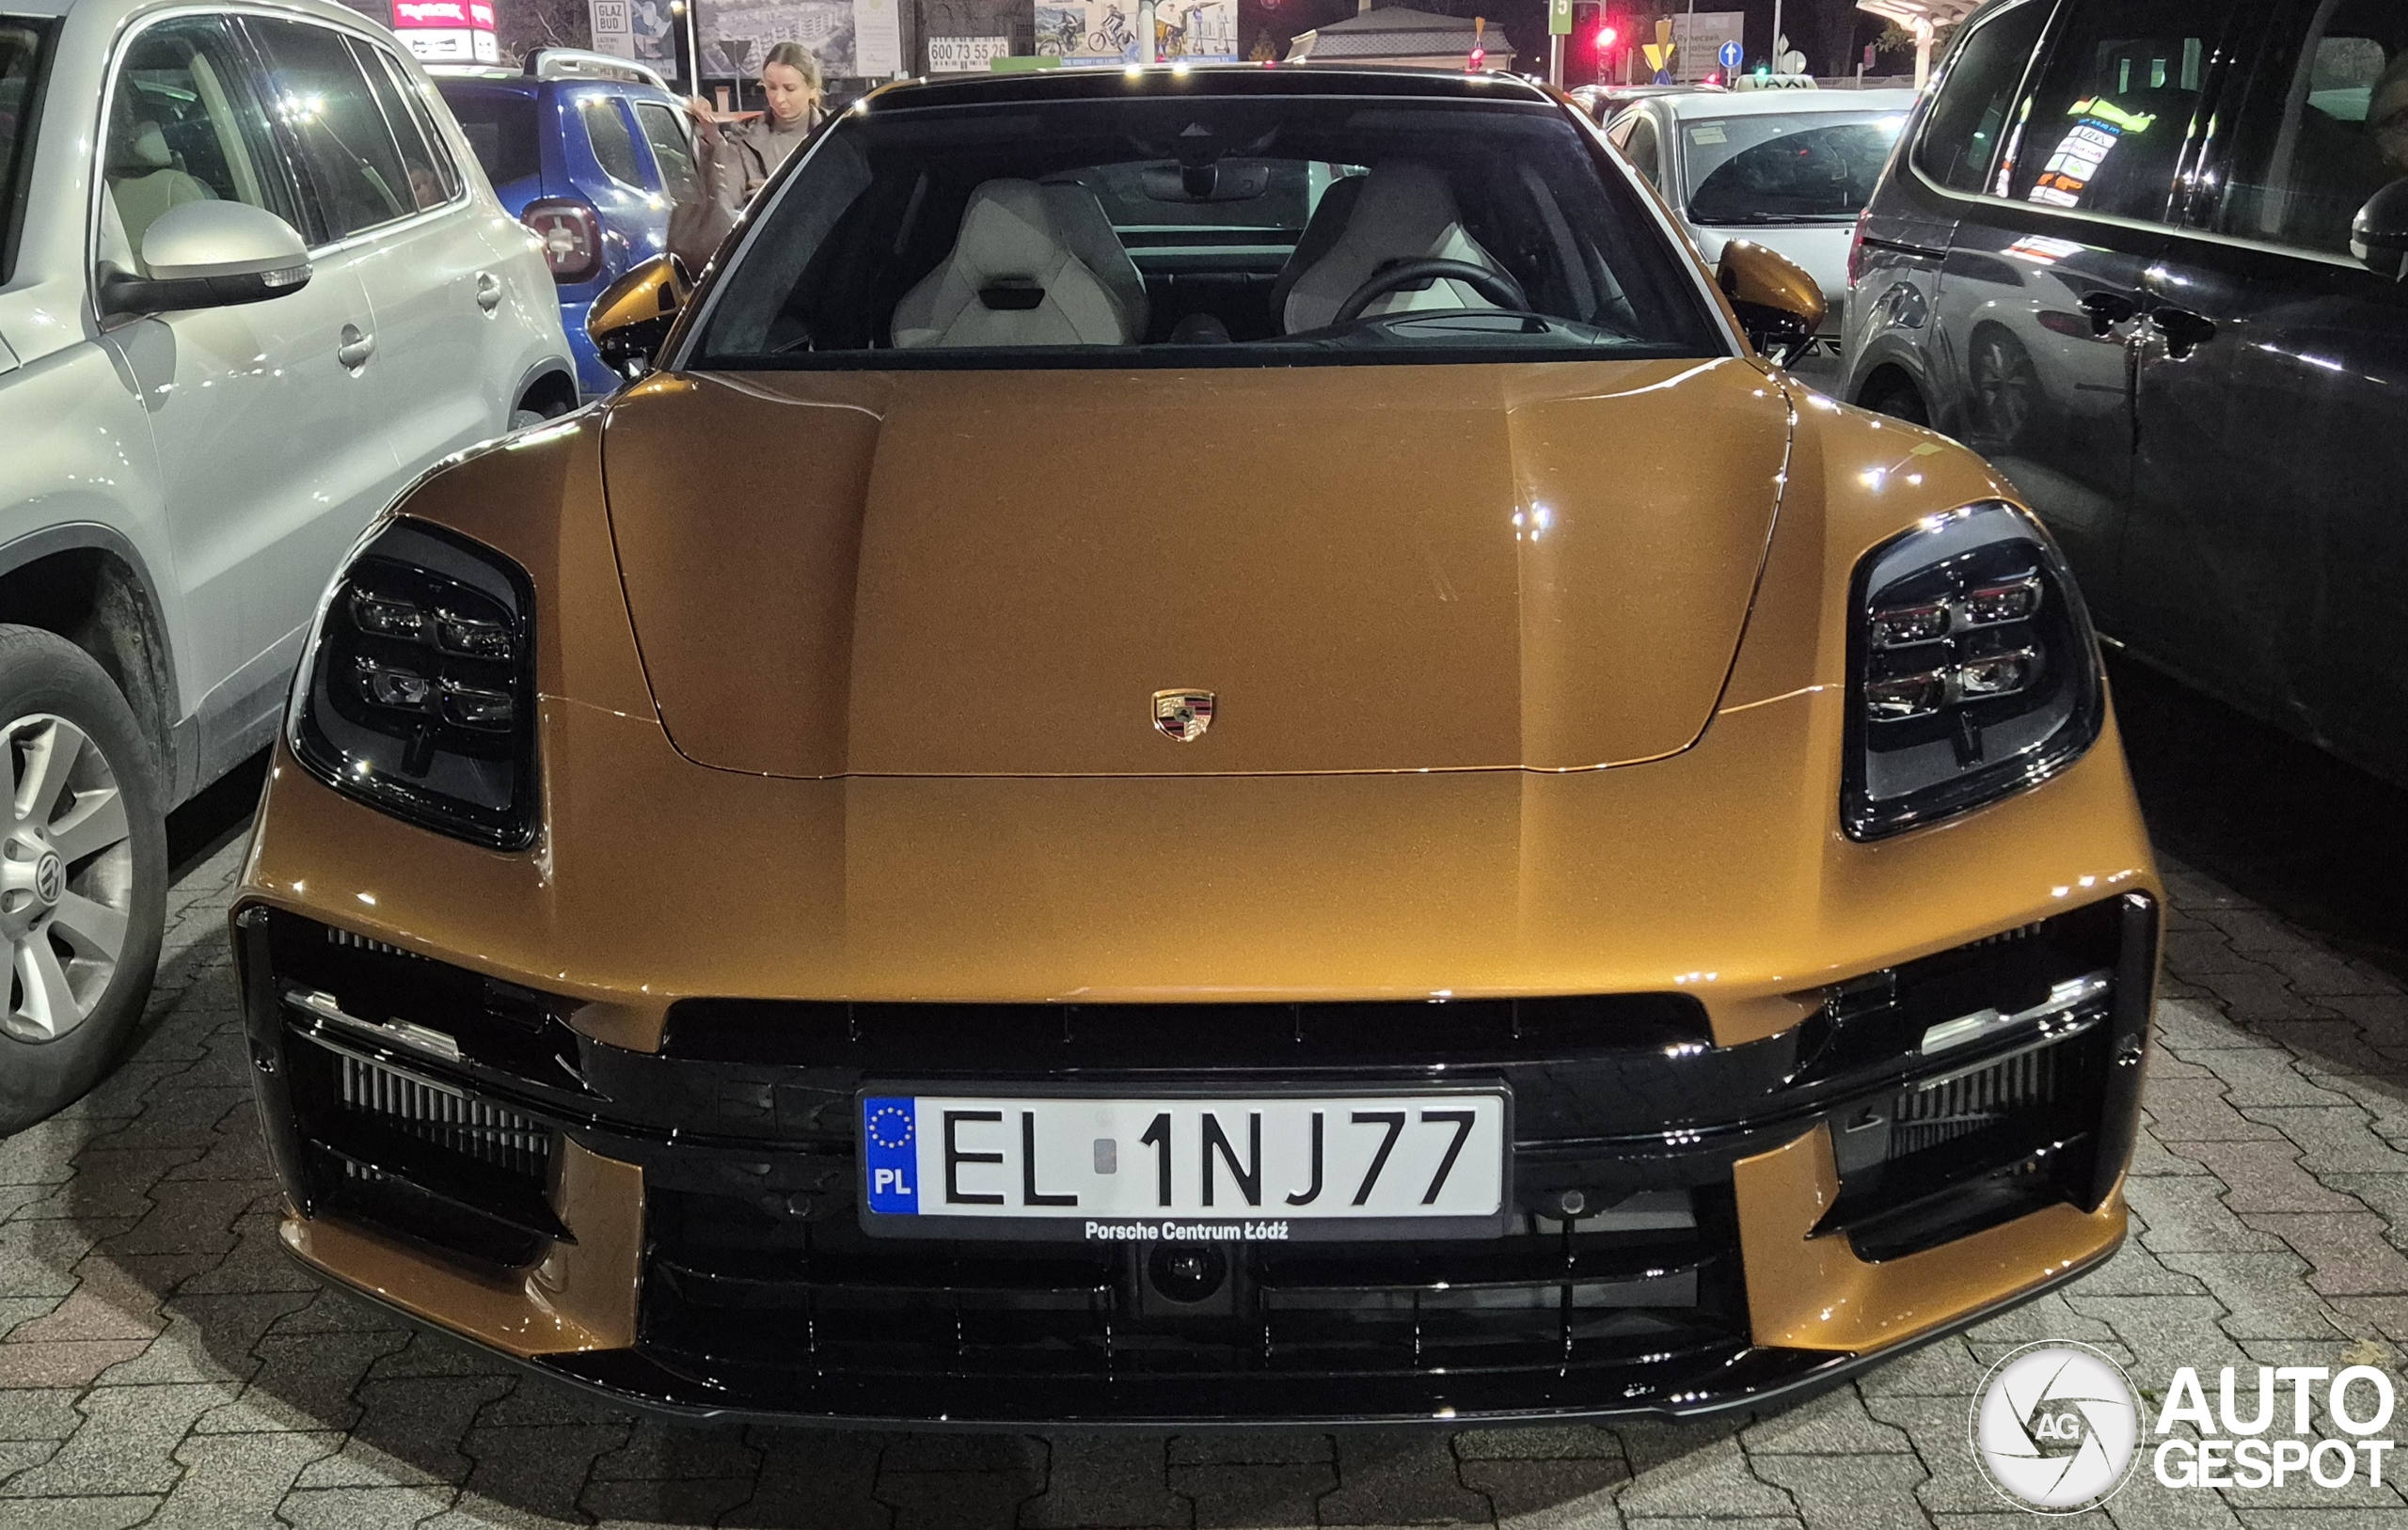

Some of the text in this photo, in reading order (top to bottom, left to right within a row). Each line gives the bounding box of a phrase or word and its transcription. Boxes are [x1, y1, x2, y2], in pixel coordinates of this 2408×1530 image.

[598, 5, 622, 17] GLAZ
[1558, 0, 1568, 15] 5
[600, 18, 619, 29] BUD
[931, 43, 1006, 59] 600 73 55 26
[1750, 76, 1808, 88] TAXI
[943, 1110, 1478, 1207] EL 1NJ77
[874, 1168, 911, 1195] PL
[1085, 1220, 1289, 1240] Porsche Centrum Łódź
